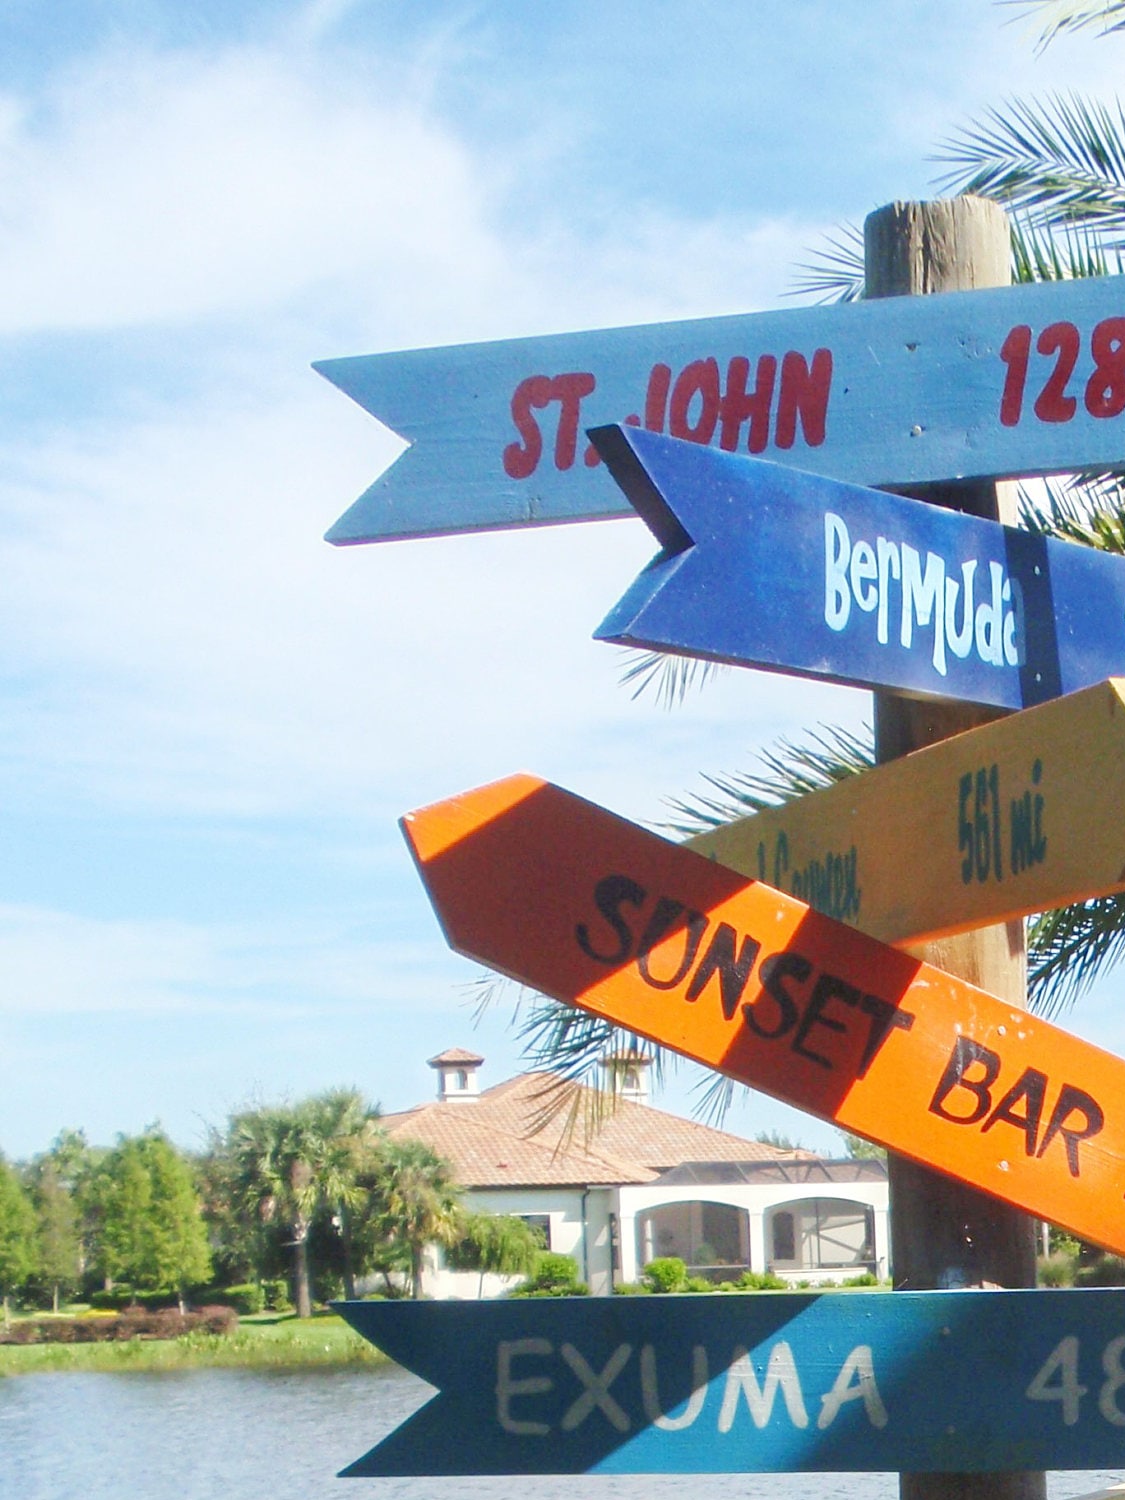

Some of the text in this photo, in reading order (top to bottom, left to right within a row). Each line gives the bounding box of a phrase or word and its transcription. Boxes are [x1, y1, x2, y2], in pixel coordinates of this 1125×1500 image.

[624, 348, 833, 454] JOHN
[958, 763, 1002, 885] 561
[1010, 758, 1047, 876] mi
[575, 874, 912, 1080] SUNSET
[928, 1035, 1104, 1178] BAR
[496, 1338, 888, 1434] EXUMA
